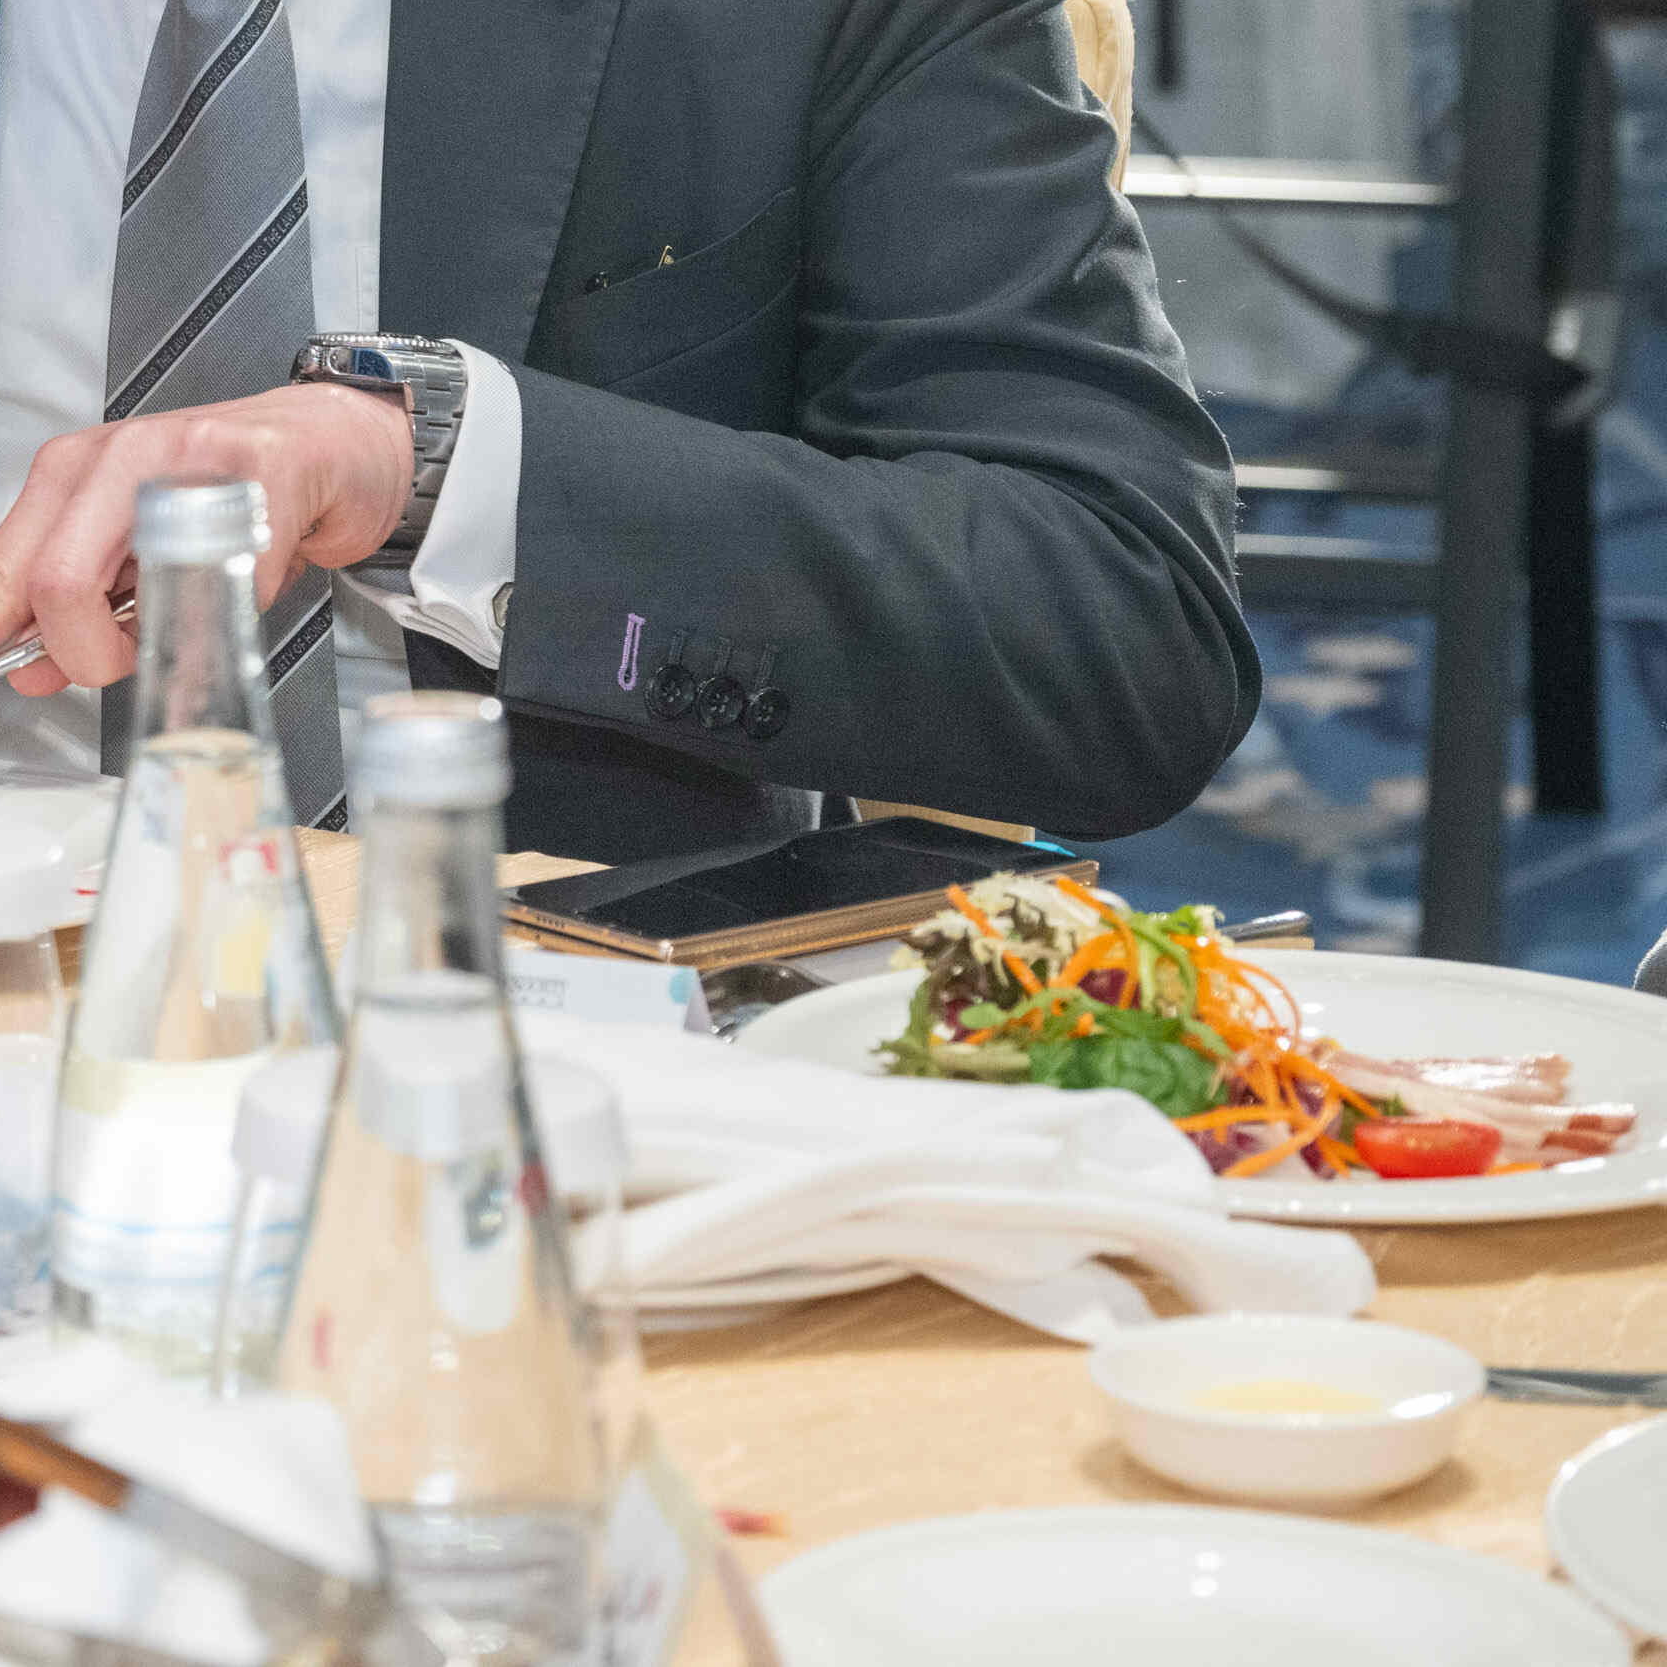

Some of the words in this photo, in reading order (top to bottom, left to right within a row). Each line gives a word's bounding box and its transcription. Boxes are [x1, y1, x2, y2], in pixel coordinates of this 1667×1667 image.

[227, 46, 241, 61] OF
[237, 22, 259, 50] HONG
[254, 0, 274, 27] KONG
[242, 244, 267, 271] KONG
[263, 228, 281, 247] THE
[276, 209, 296, 233] LAW
